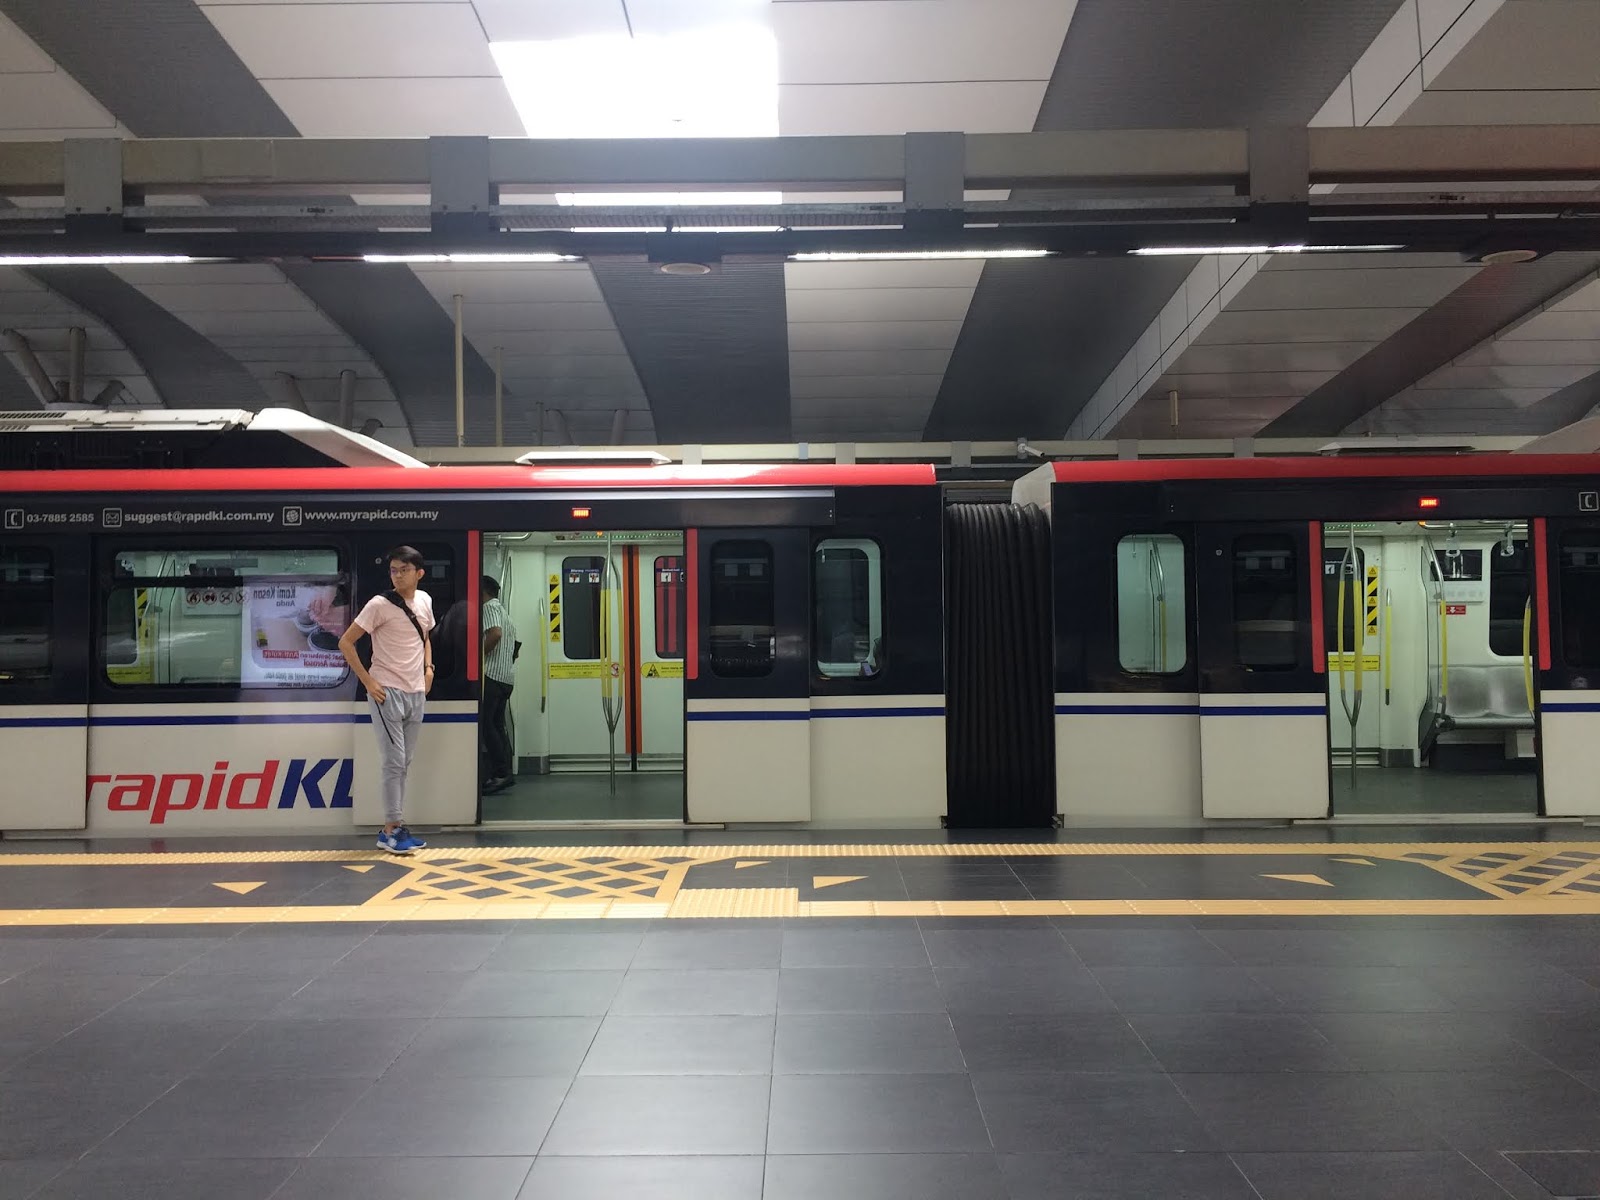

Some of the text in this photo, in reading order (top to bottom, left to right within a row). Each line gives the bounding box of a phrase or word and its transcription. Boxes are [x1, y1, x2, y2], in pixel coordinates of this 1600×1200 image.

[26, 513, 94, 523] 03-7885 2585
[124, 510, 275, 524] suggest@rapidkl.com.my
[304, 509, 439, 522] www.myrapid.com.my
